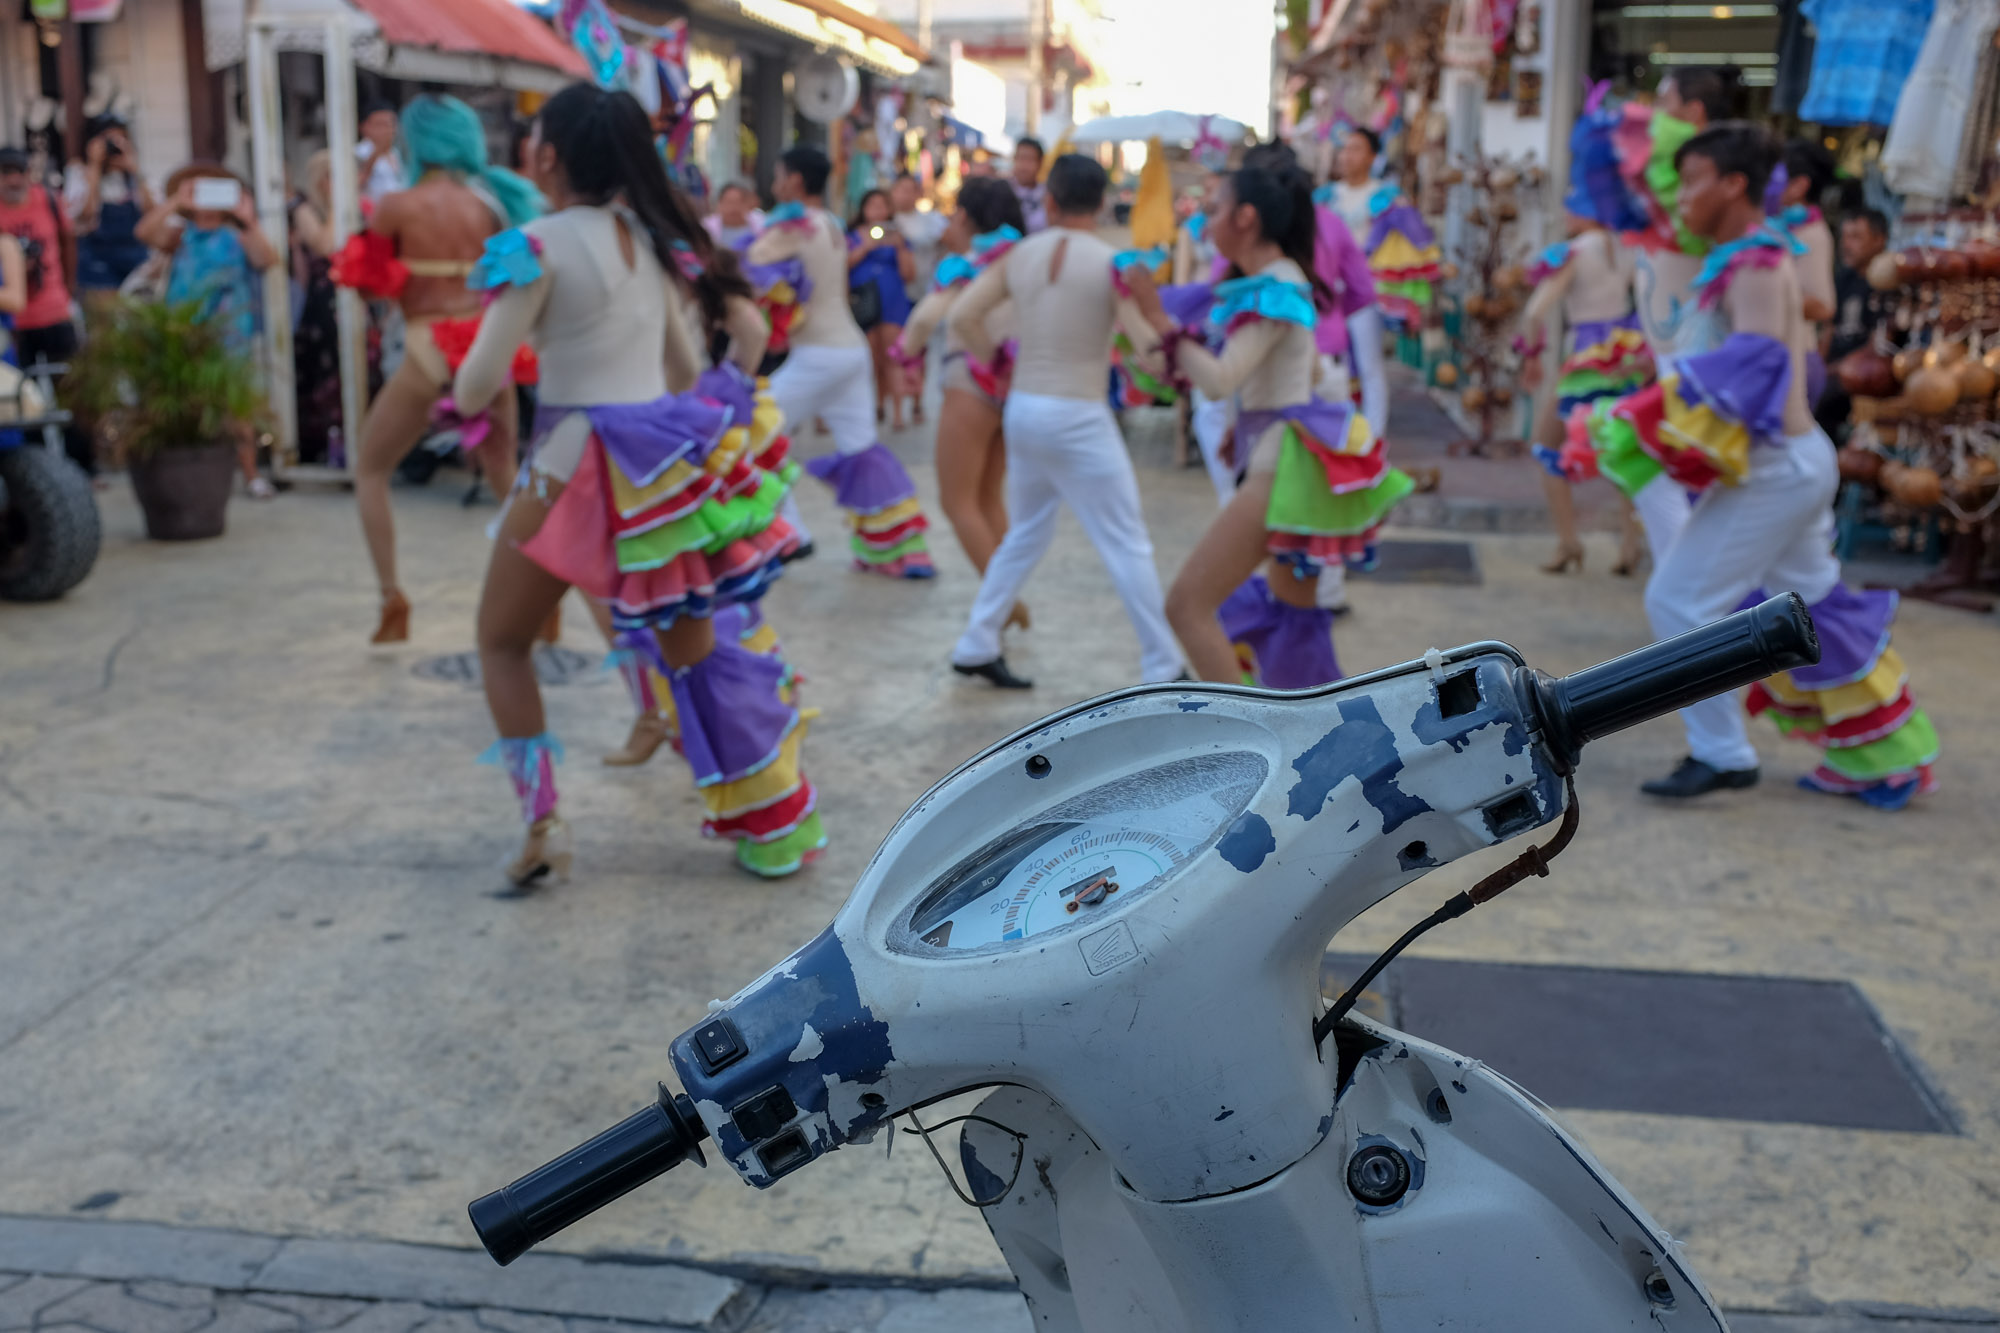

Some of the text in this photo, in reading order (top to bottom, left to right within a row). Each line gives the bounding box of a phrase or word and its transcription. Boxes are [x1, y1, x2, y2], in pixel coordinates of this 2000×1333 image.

[1070, 829, 1092, 846] 60
[1024, 858, 1044, 873] 40
[990, 898, 1010, 915] 20
[1095, 951, 1133, 971] HONDA
[1362, 1187, 1381, 1197] LOCK
